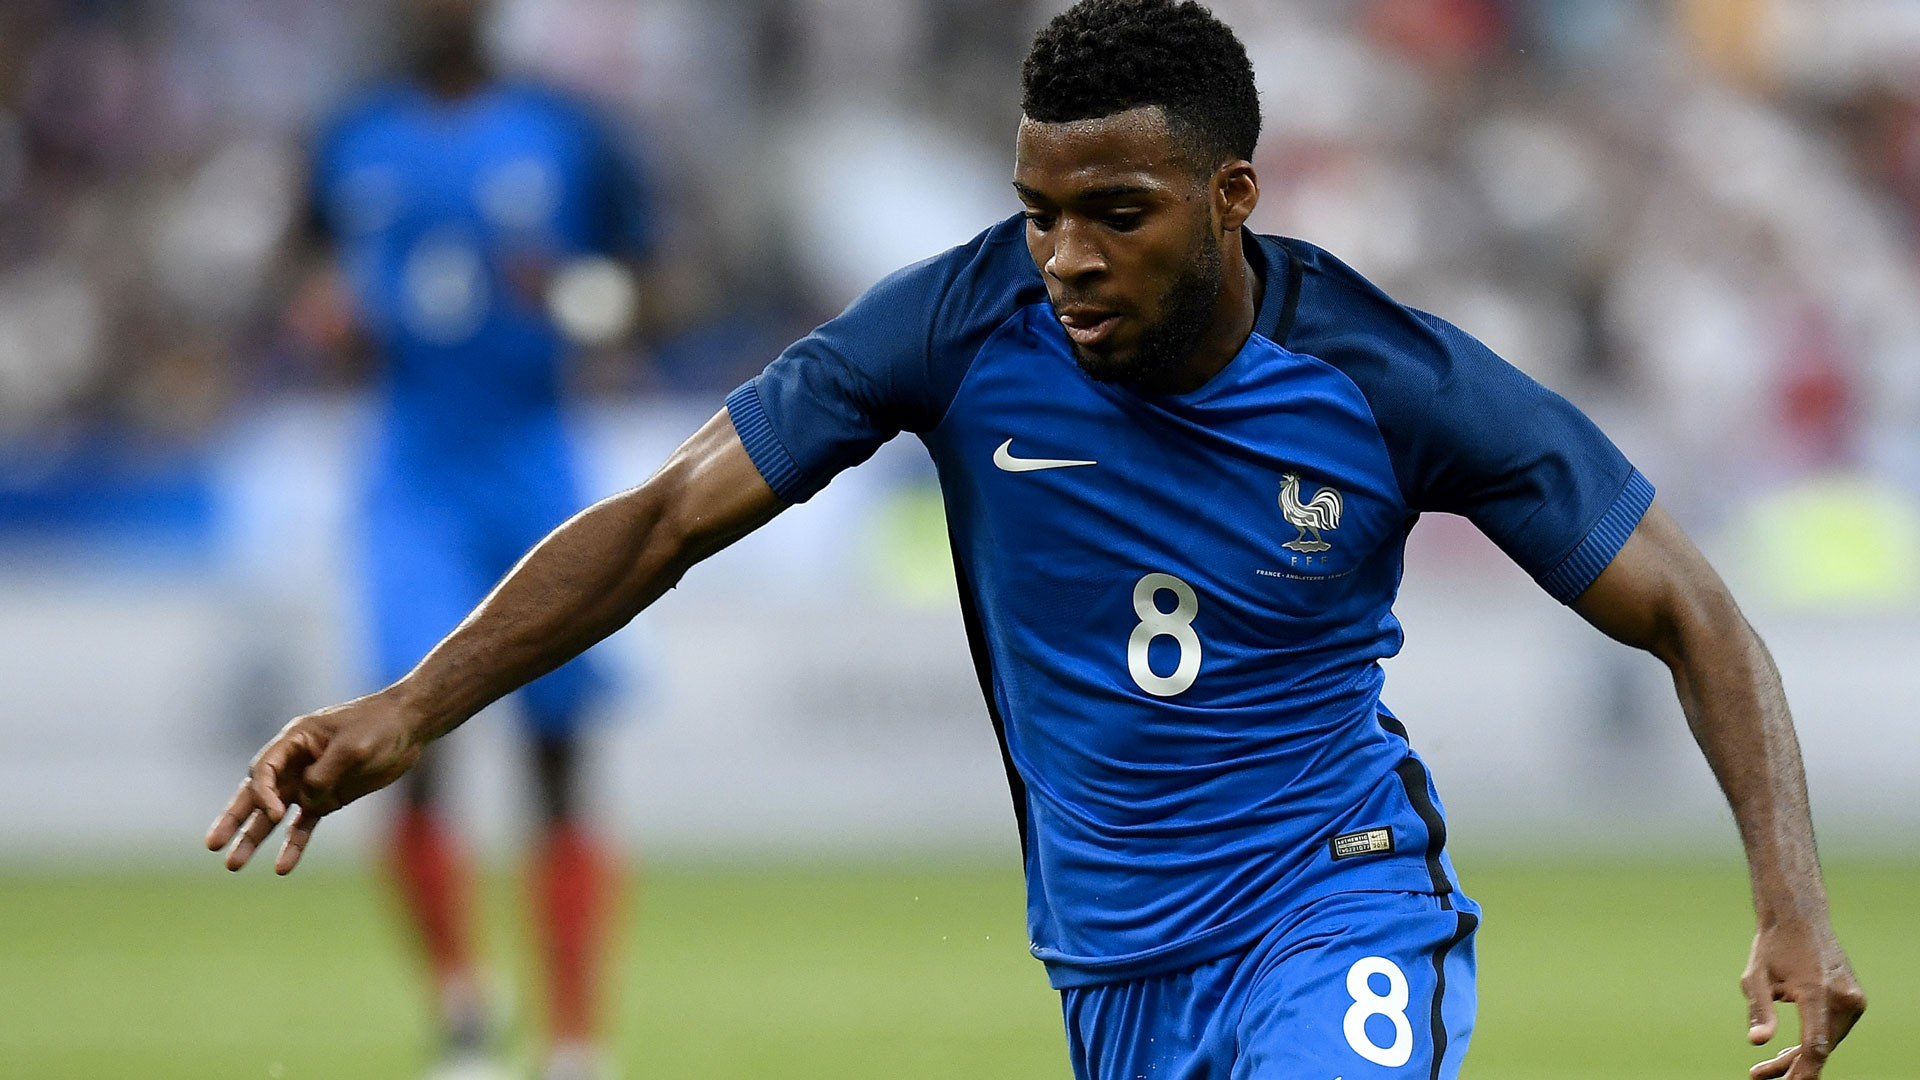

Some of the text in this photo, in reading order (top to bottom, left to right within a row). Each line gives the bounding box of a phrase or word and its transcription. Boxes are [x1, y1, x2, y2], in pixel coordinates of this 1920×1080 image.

[1256, 569, 1281, 578] FRANCE
[1286, 573, 1325, 581] ANGLETERRE
[1128, 572, 1202, 697] 8
[1337, 834, 1368, 845] AUTHENTIC
[1343, 956, 1413, 1067] 8
